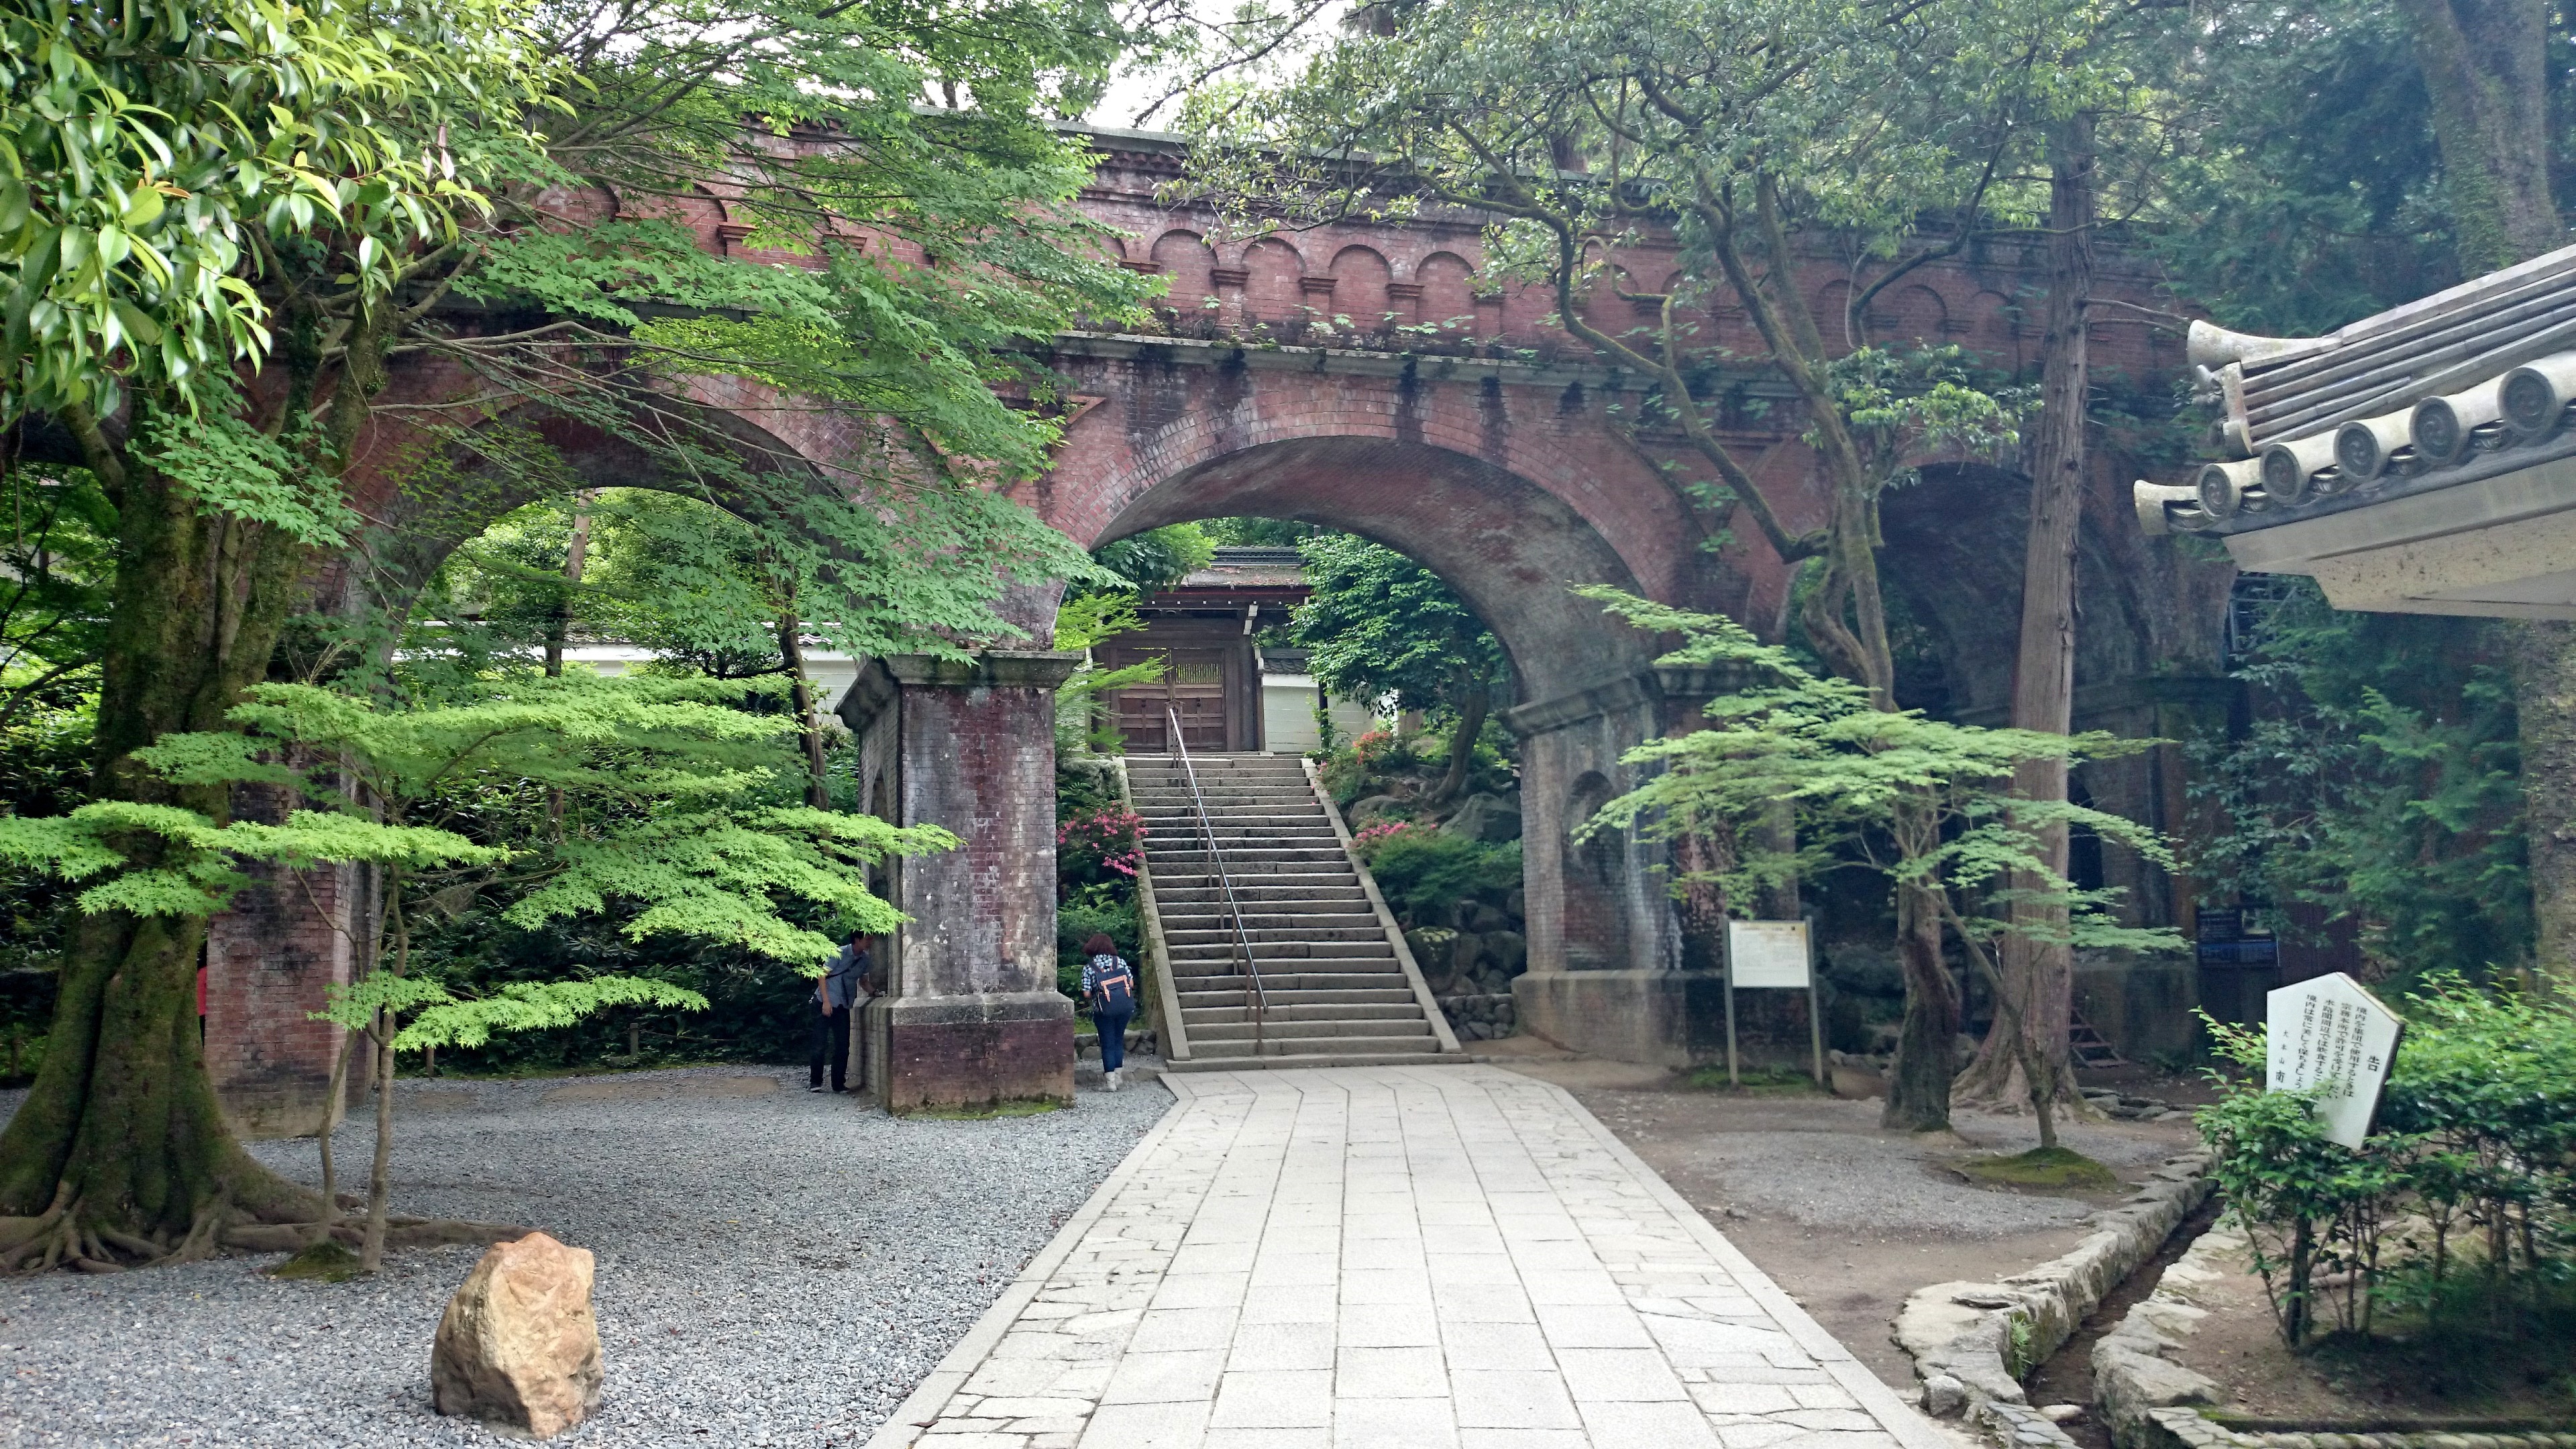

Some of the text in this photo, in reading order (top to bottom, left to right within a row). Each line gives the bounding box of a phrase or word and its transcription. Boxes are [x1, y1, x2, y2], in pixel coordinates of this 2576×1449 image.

[2327, 1003, 2353, 1099] 宗務本所で許可を受けてさい
[2367, 1055, 2380, 1071] 告
